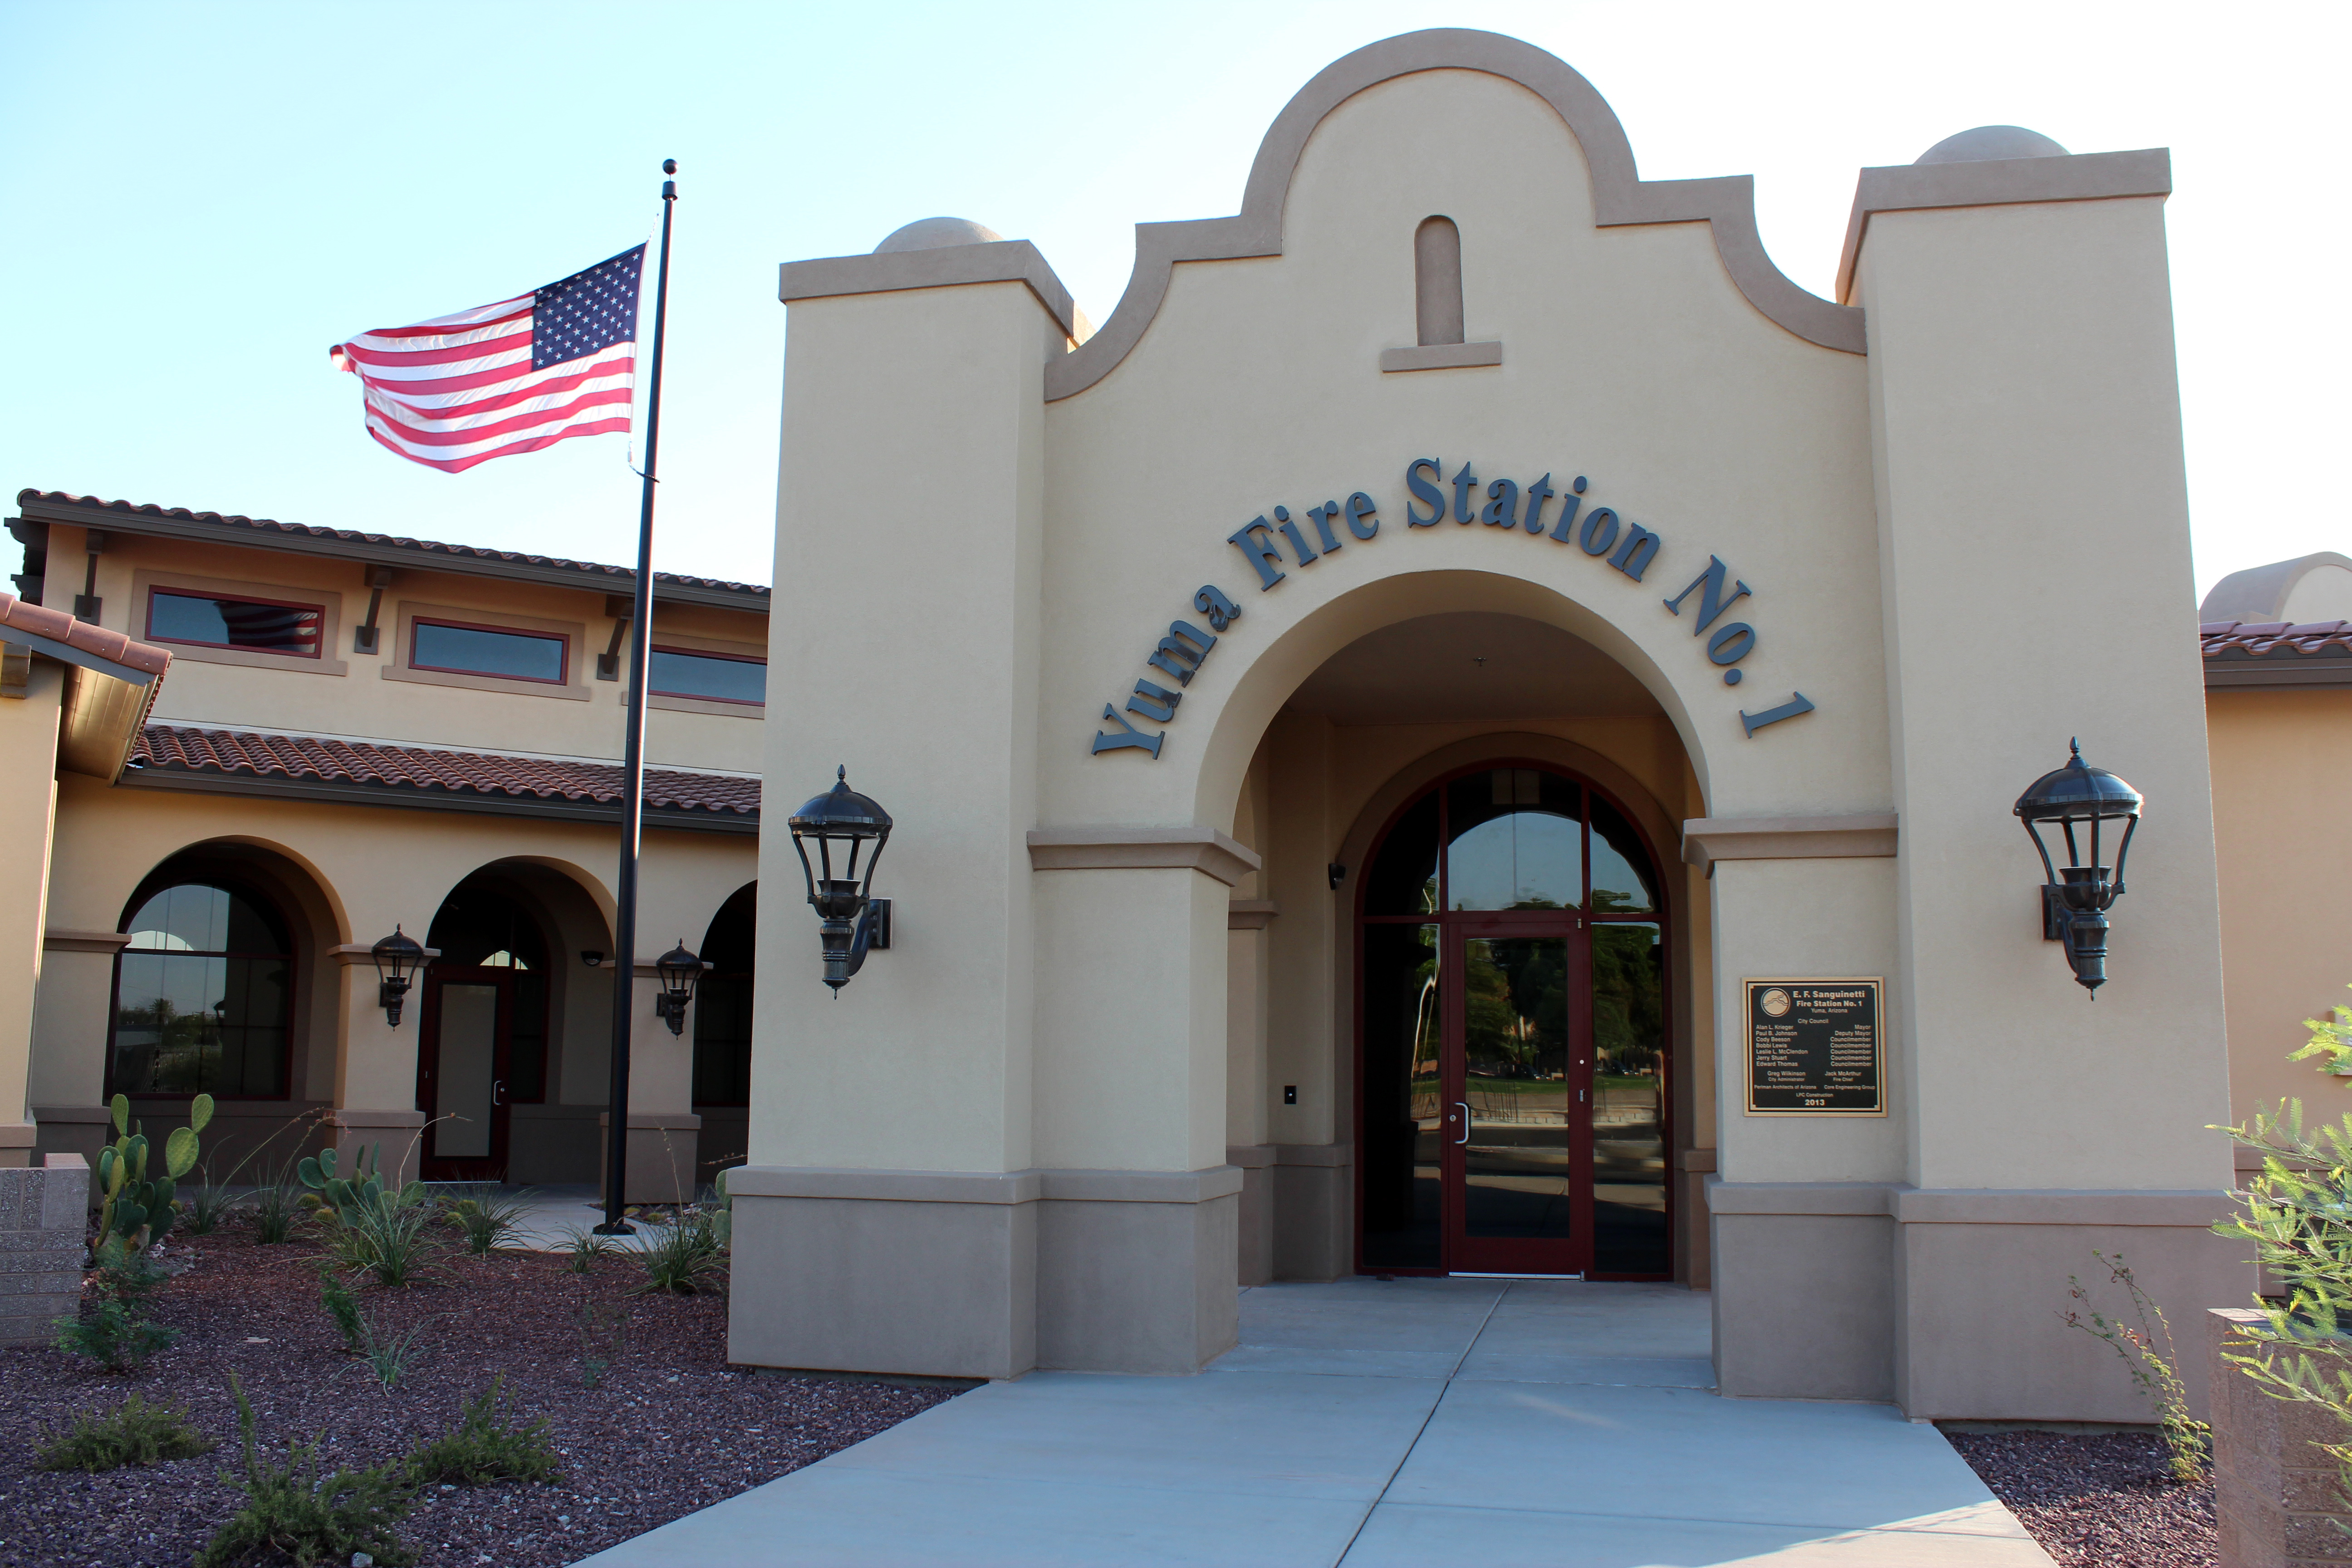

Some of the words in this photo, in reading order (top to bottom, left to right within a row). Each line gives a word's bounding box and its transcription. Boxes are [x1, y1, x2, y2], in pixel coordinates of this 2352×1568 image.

[1091, 585, 1242, 760] Yuma
[1227, 492, 1379, 590] Fire
[1407, 457, 1662, 581] Station
[1664, 554, 1757, 686] No.
[1739, 691, 1816, 738] 1
[1812, 990, 1865, 999] Sanguinetti
